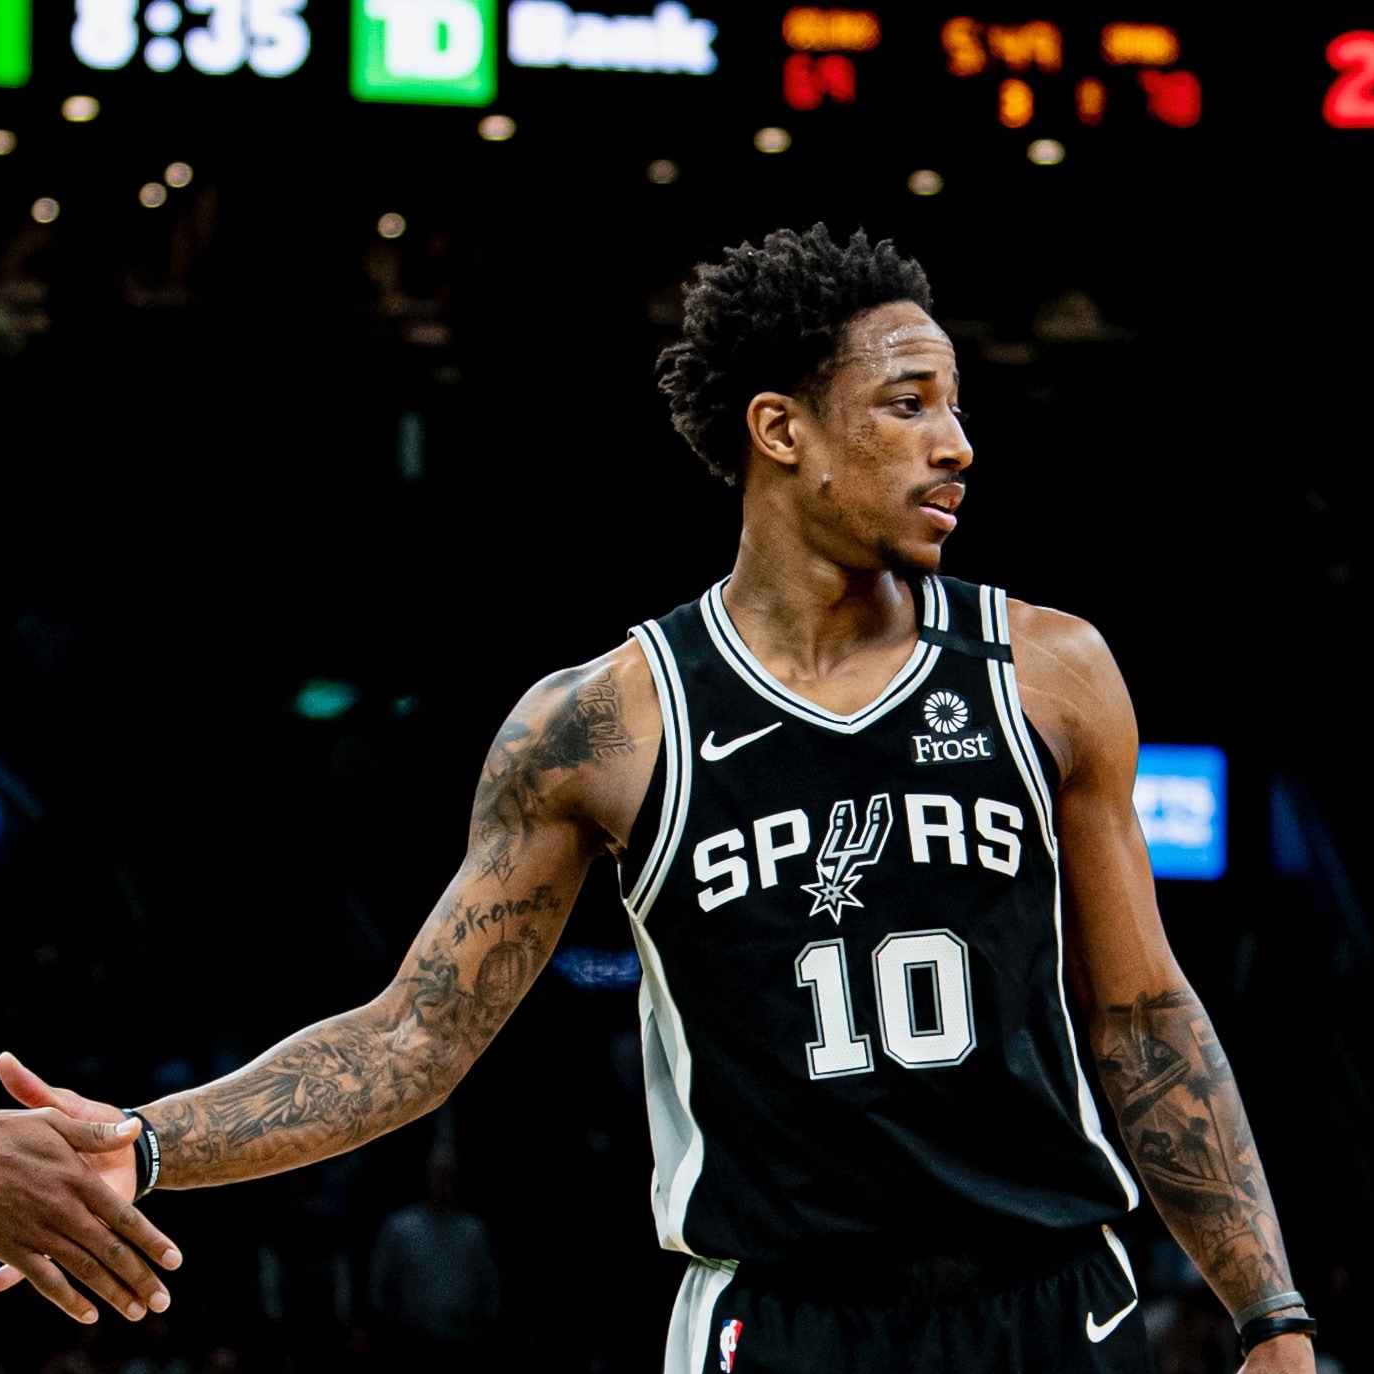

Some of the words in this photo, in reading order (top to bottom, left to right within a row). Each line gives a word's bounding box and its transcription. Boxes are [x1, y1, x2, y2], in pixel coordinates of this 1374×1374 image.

[361, 0, 484, 79] TD
[911, 732, 991, 764] Frost
[693, 793, 1024, 924] SPURS
[794, 928, 977, 1080] 10
